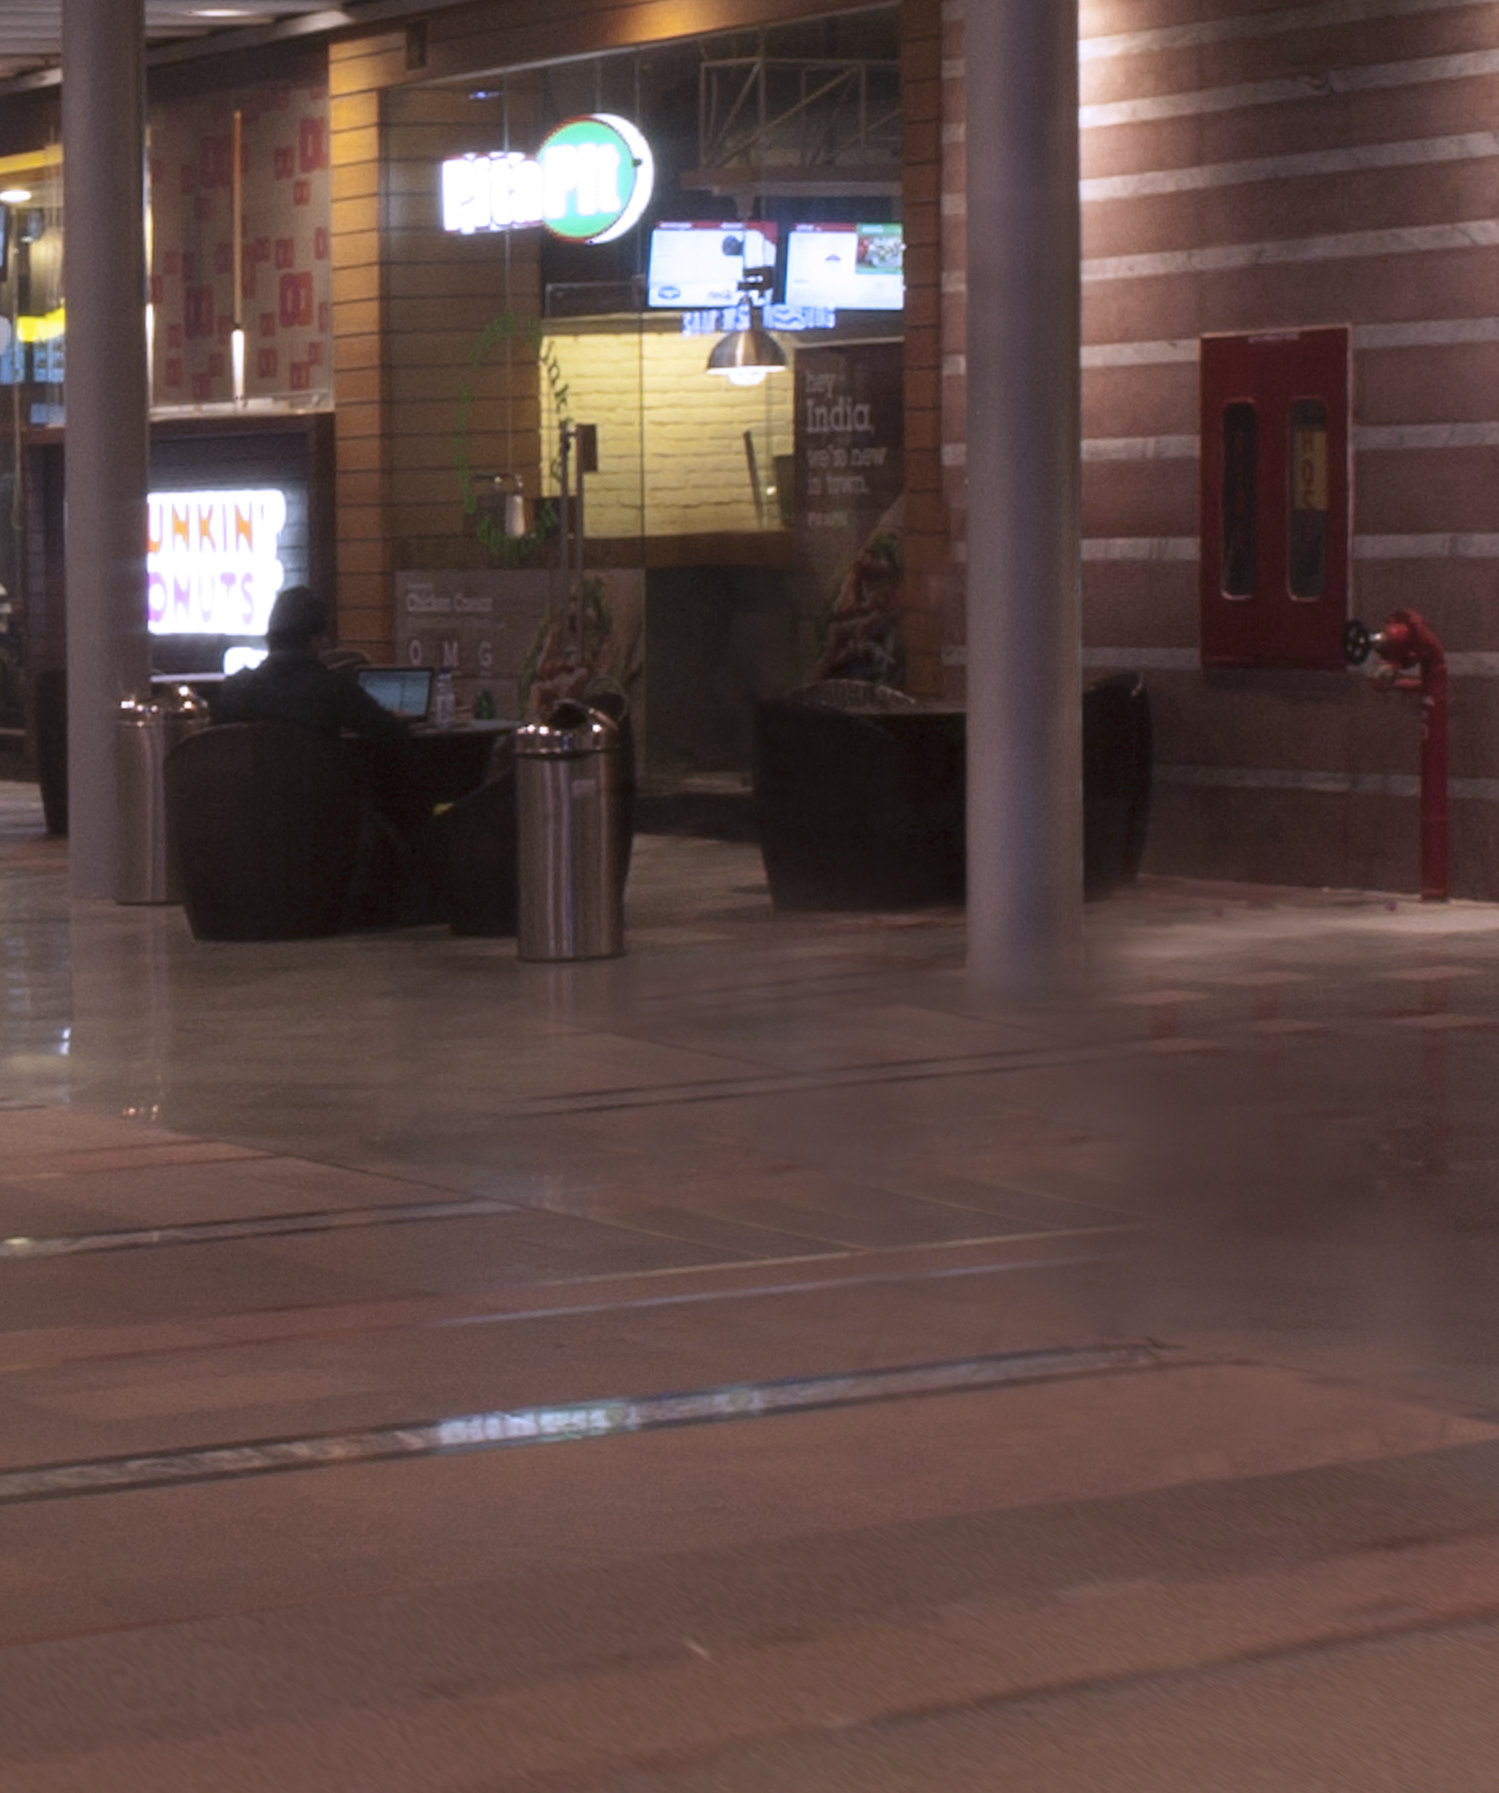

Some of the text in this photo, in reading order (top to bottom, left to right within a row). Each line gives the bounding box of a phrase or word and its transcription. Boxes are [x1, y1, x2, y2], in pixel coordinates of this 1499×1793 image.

[805, 396, 876, 437] India,
[147, 499, 267, 553] UNKIN'
[147, 570, 257, 627] ONUTS
